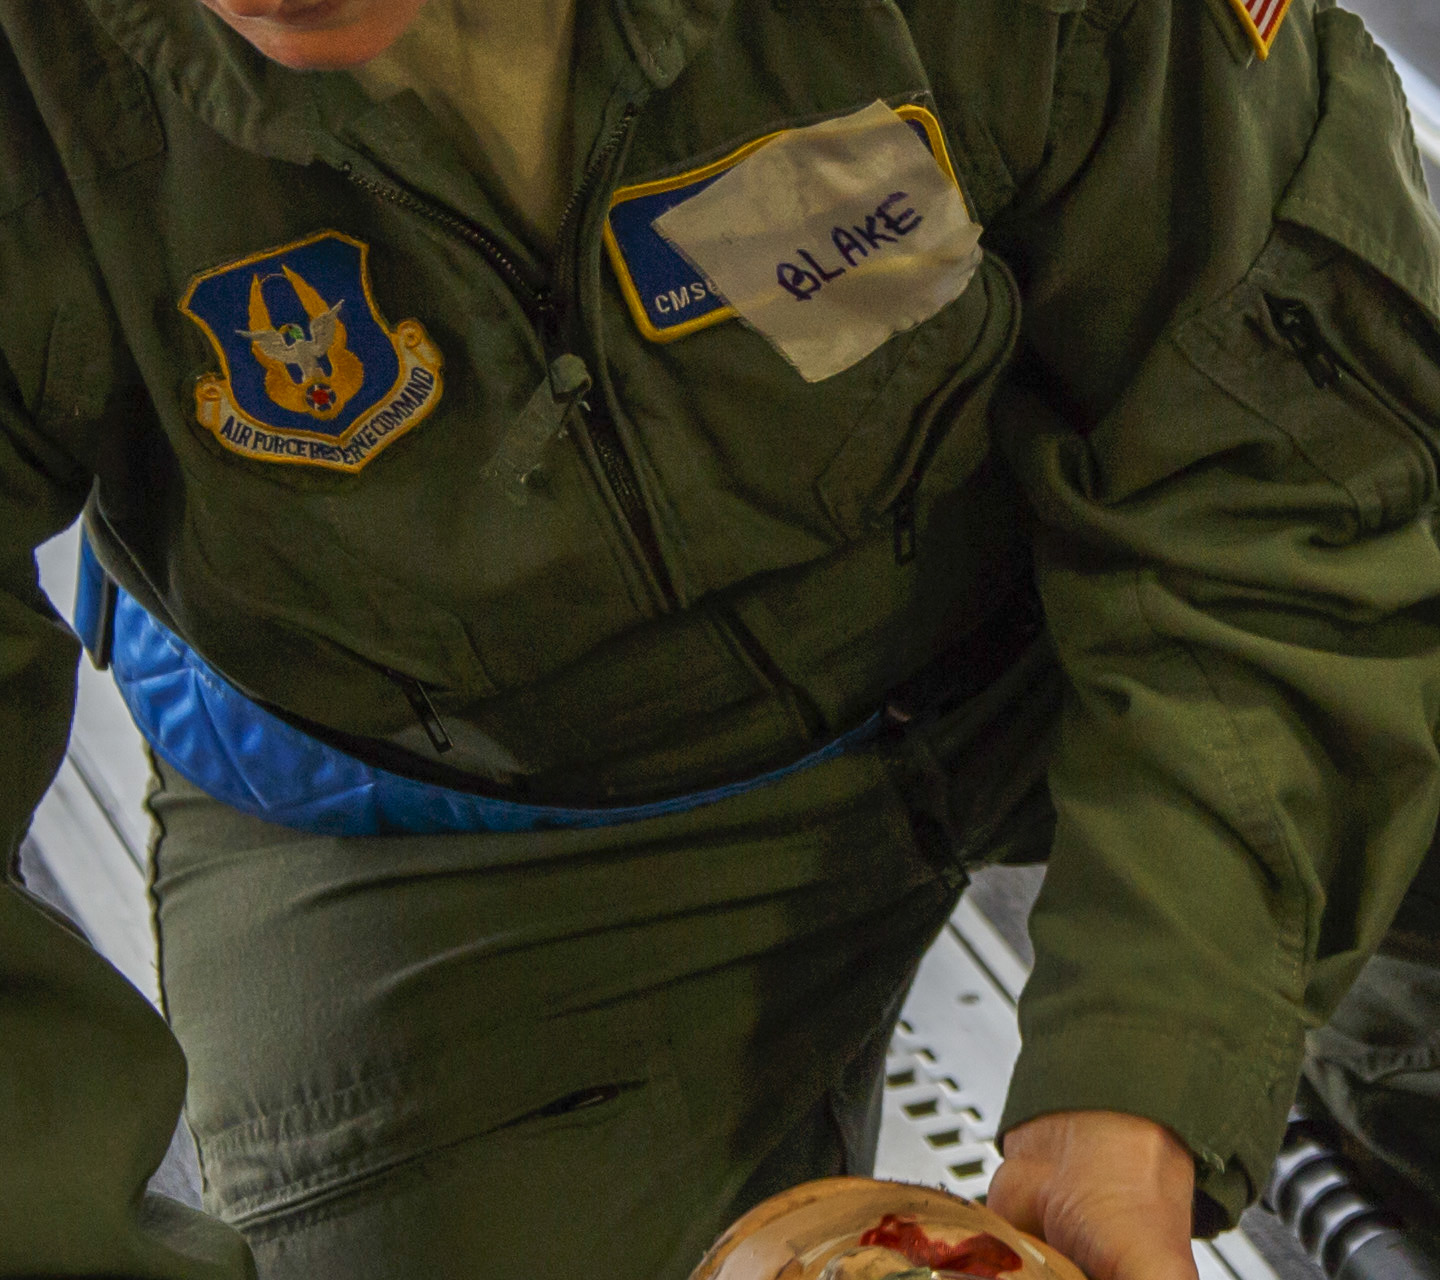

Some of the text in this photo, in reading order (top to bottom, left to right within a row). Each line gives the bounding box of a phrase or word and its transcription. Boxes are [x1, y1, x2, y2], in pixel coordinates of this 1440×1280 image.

[776, 191, 924, 301] BLAKE
[220, 415, 253, 448] AIR
[252, 433, 307, 457] FORCE
[370, 366, 435, 437] COMMAND
